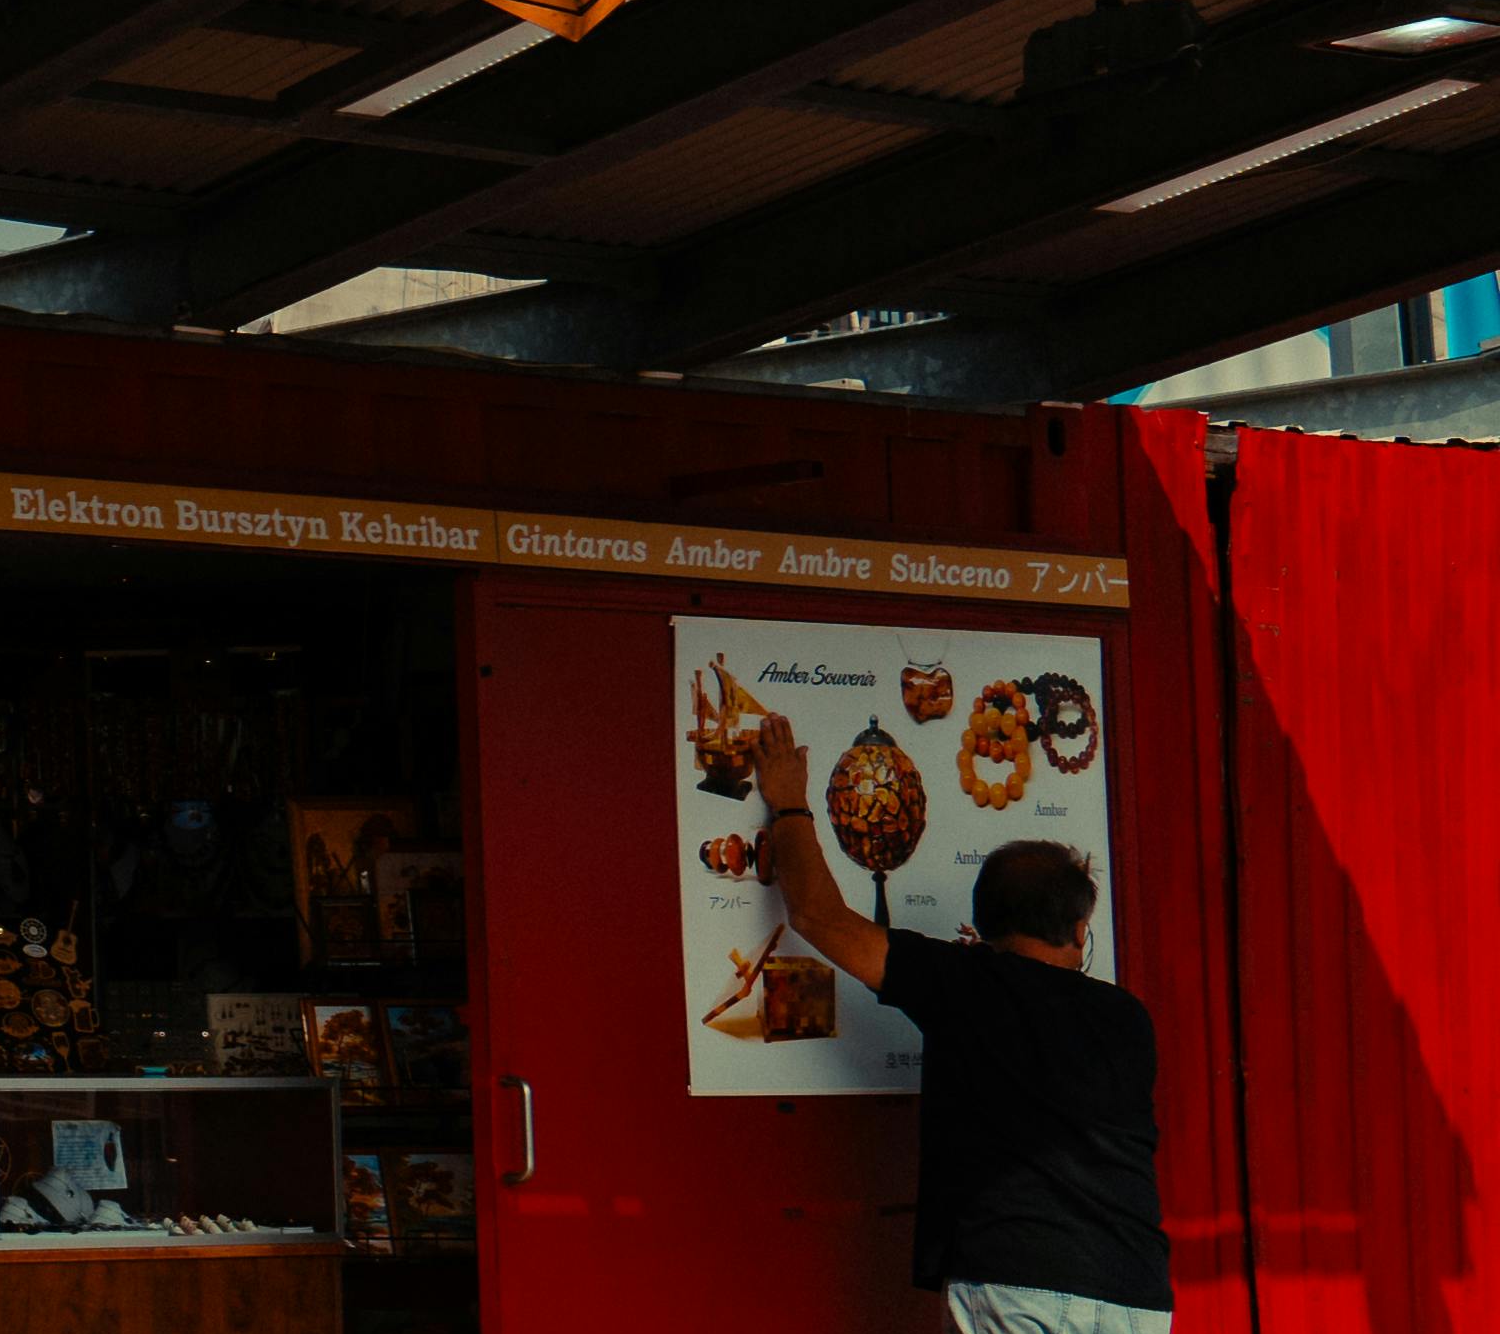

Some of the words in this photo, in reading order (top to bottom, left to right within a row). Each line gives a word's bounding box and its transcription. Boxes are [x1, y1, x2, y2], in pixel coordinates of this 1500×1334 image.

[11, 487, 163, 531] Elektron
[175, 500, 329, 546] Bursztyn
[339, 510, 479, 552] Kehribar
[506, 524, 647, 565] Gintaras
[665, 537, 761, 573] Amber
[778, 545, 871, 581] Ambre
[888, 553, 1010, 590] Sukceno
[1025, 561, 1129, 595] アンバー
[757, 661, 810, 684] Amber
[811, 664, 877, 687] Souvenir
